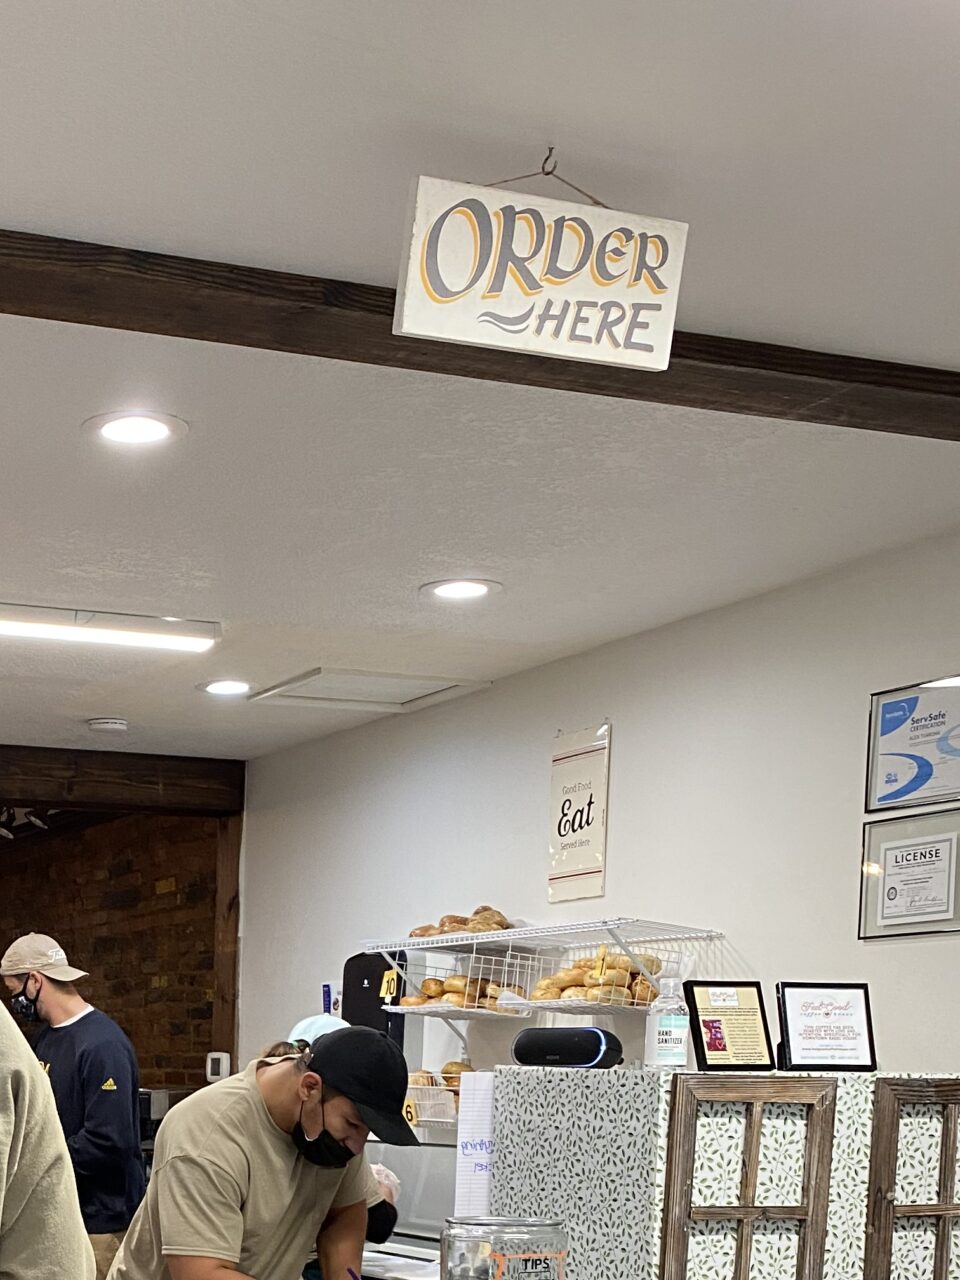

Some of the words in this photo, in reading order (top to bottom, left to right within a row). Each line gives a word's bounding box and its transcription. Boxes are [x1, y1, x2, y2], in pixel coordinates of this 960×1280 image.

[420, 198, 669, 304] ORDER
[534, 298, 662, 353] HERE
[911, 710, 946, 725] ServSafe
[557, 792, 595, 837] Eat
[895, 848, 941, 864] LICENSE
[385, 977, 396, 995] 10
[657, 1037, 682, 1045] SANITIZER
[405, 1104, 413, 1122] 6
